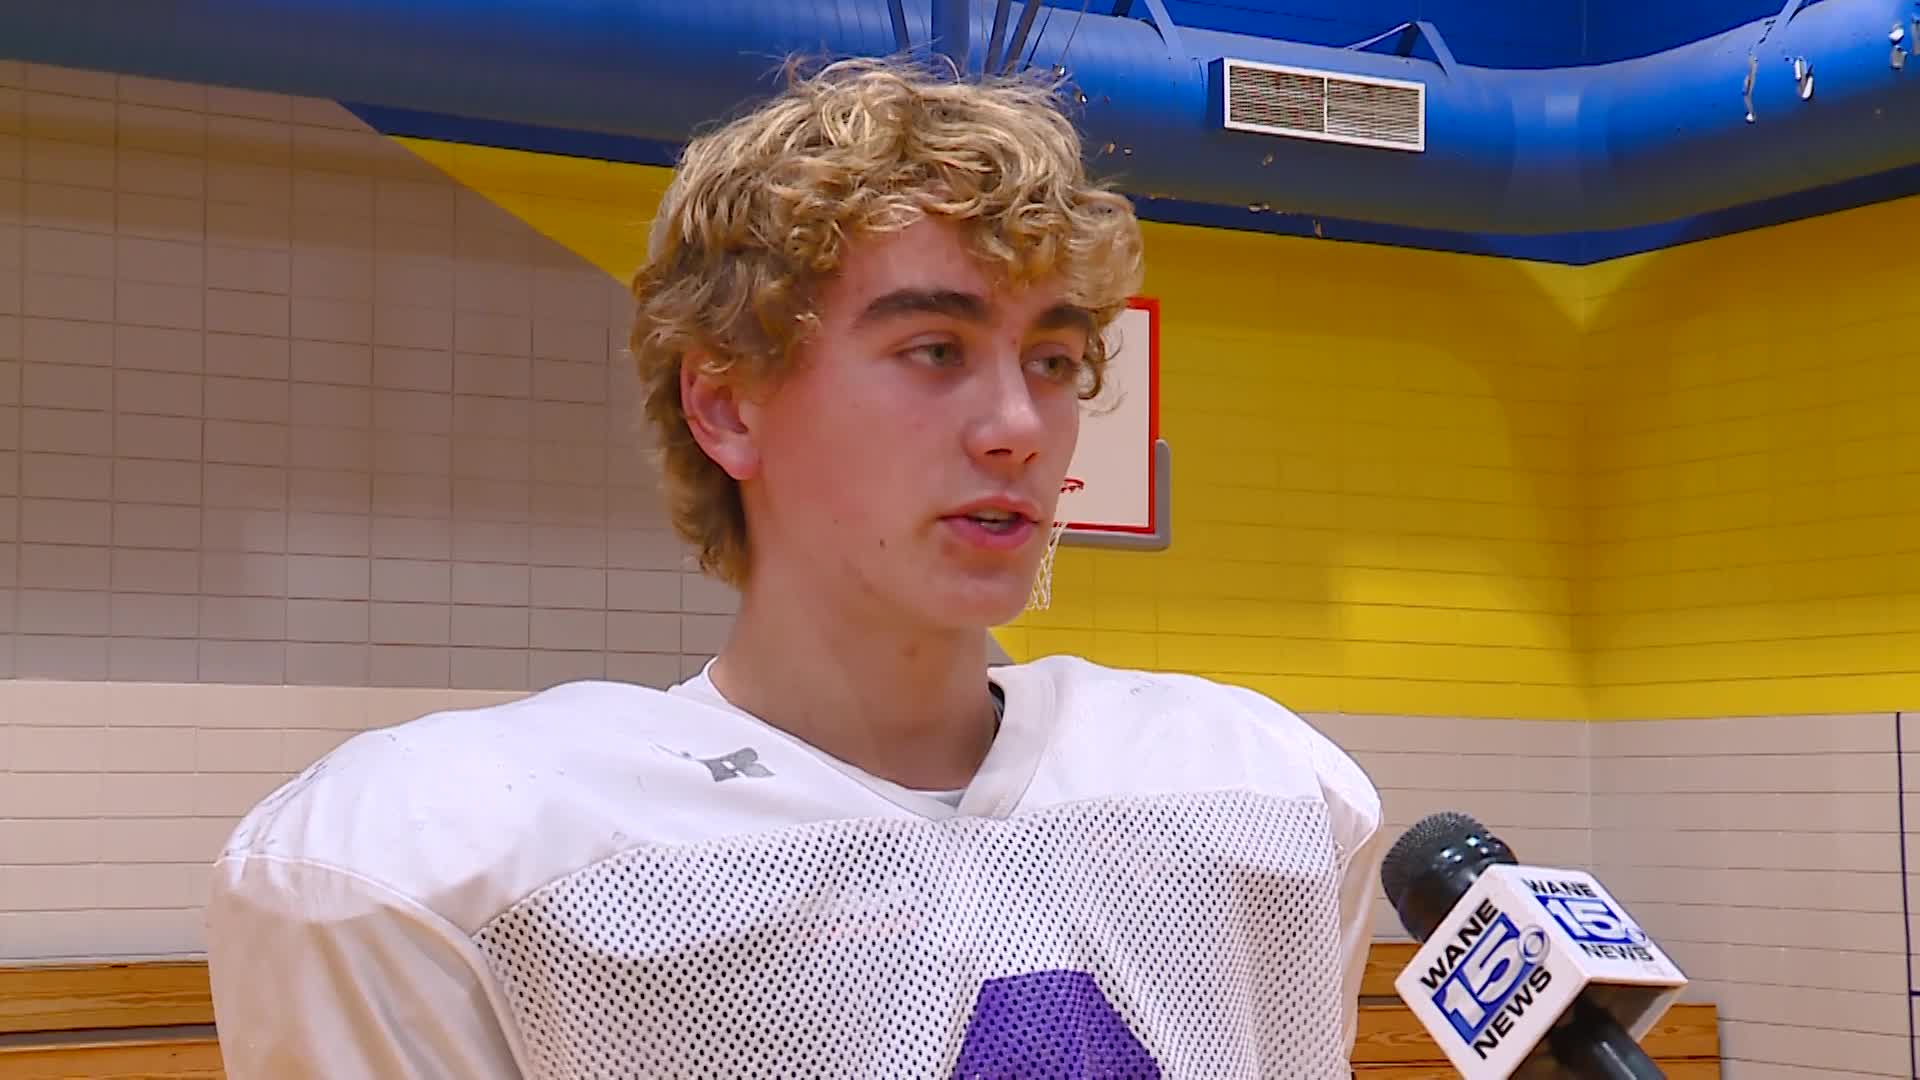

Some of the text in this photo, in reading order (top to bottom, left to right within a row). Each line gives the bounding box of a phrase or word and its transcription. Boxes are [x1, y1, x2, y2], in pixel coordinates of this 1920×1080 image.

[1520, 878, 1598, 898] WANE
[1539, 896, 1631, 942] 15
[1420, 898, 1498, 989] WANE
[1435, 914, 1530, 1040] 15
[1579, 943, 1654, 961] NEWS
[1473, 966, 1552, 1060] NEWS
